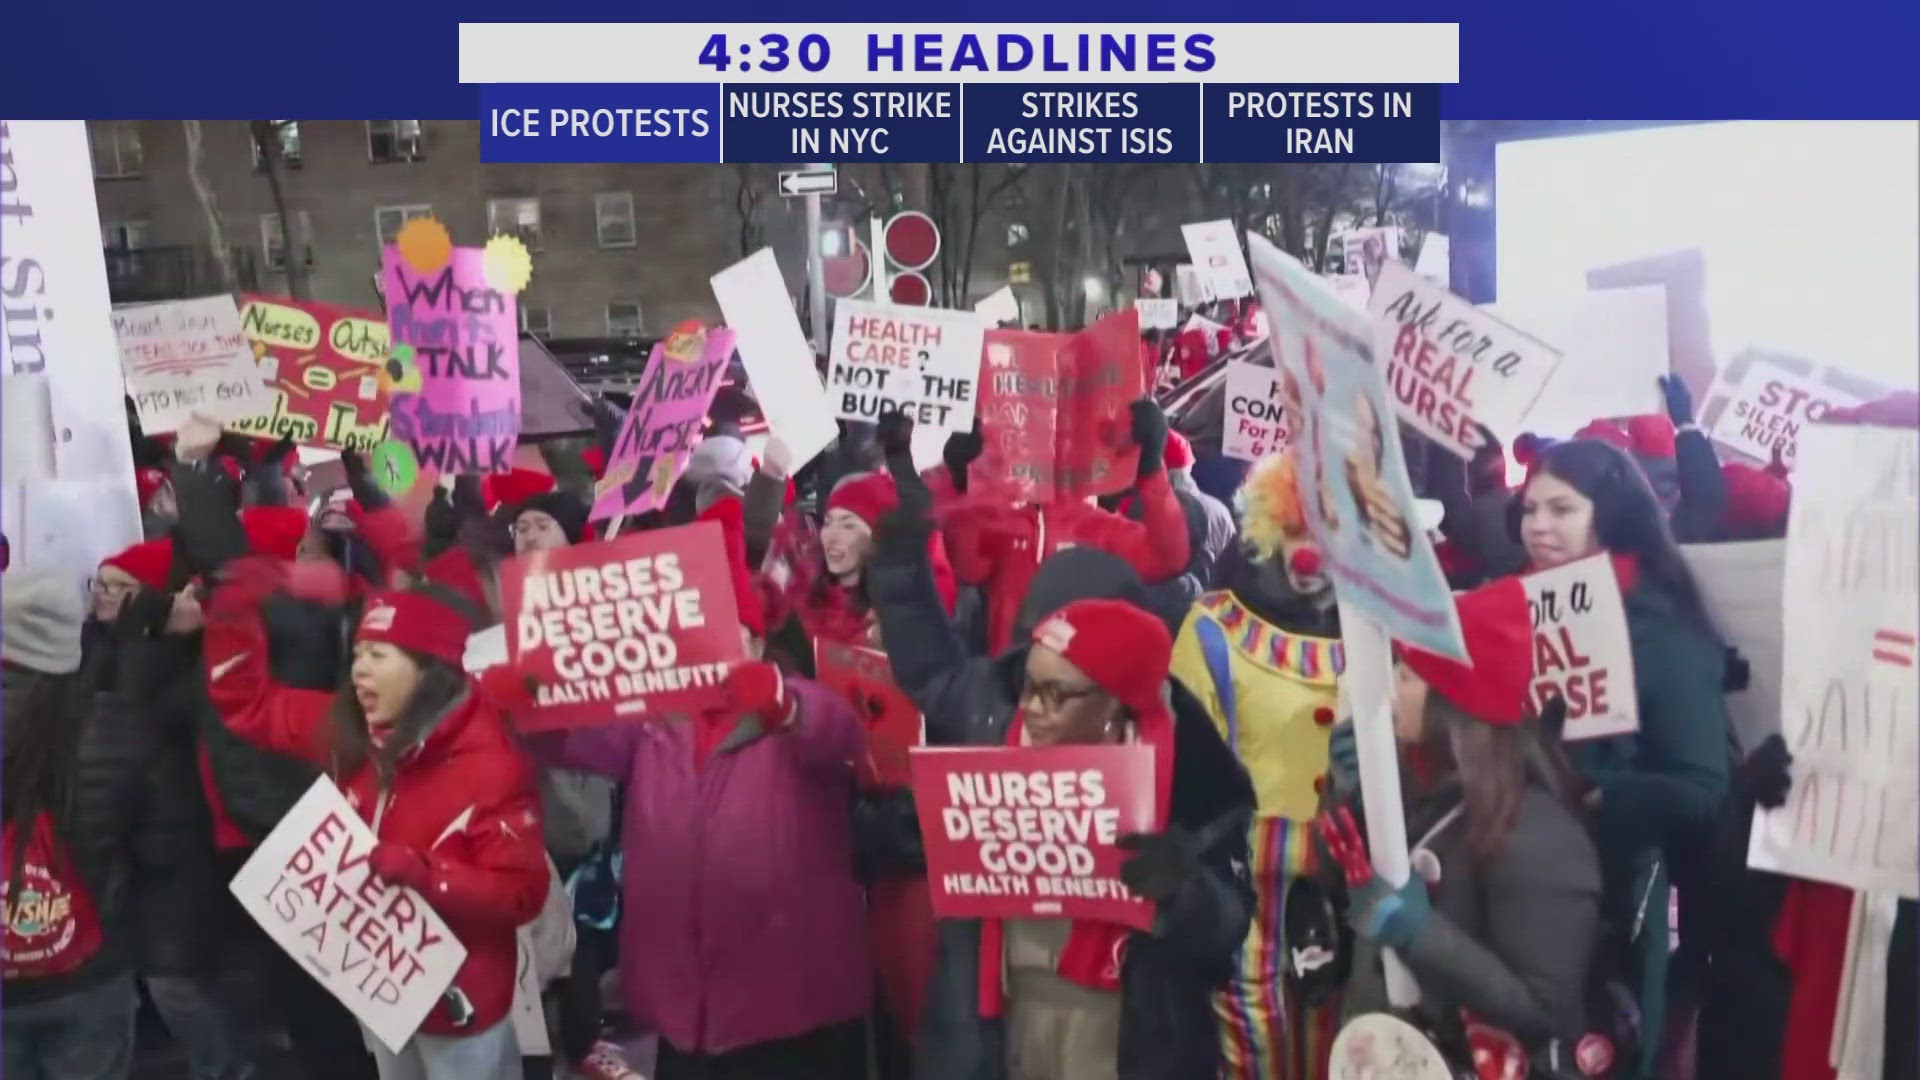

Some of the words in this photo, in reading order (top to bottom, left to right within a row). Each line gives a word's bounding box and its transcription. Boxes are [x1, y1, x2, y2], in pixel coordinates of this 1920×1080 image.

[396, 265, 506, 315] When
[242, 304, 314, 344] Nurses
[848, 315, 942, 347] HEALTH
[417, 344, 510, 381] TALK
[834, 362, 890, 390] NOT
[921, 374, 971, 402] THE
[1393, 322, 1474, 408] REAL
[1231, 395, 1283, 424] CON
[1734, 400, 1800, 438] SILEN
[1758, 380, 1832, 424] STO
[410, 437, 511, 475] WALK
[1740, 423, 1796, 458] NURS
[521, 553, 685, 613] NURSES
[517, 588, 705, 653] DESERVE
[552, 631, 678, 682] GOOD
[1534, 626, 1591, 678] AL
[533, 678, 610, 708] EALTH
[946, 768, 1107, 809] NURSES
[942, 806, 1121, 846] DESERVE
[979, 841, 1096, 877] GOOD
[309, 811, 443, 954] EVERY
[943, 872, 1031, 896] HEALTH
[1034, 876, 1143, 904] BENEFIT
[285, 844, 427, 986] PATIENT
[263, 874, 305, 924] IS
[300, 921, 328, 953] A
[341, 943, 402, 1006] VIP
